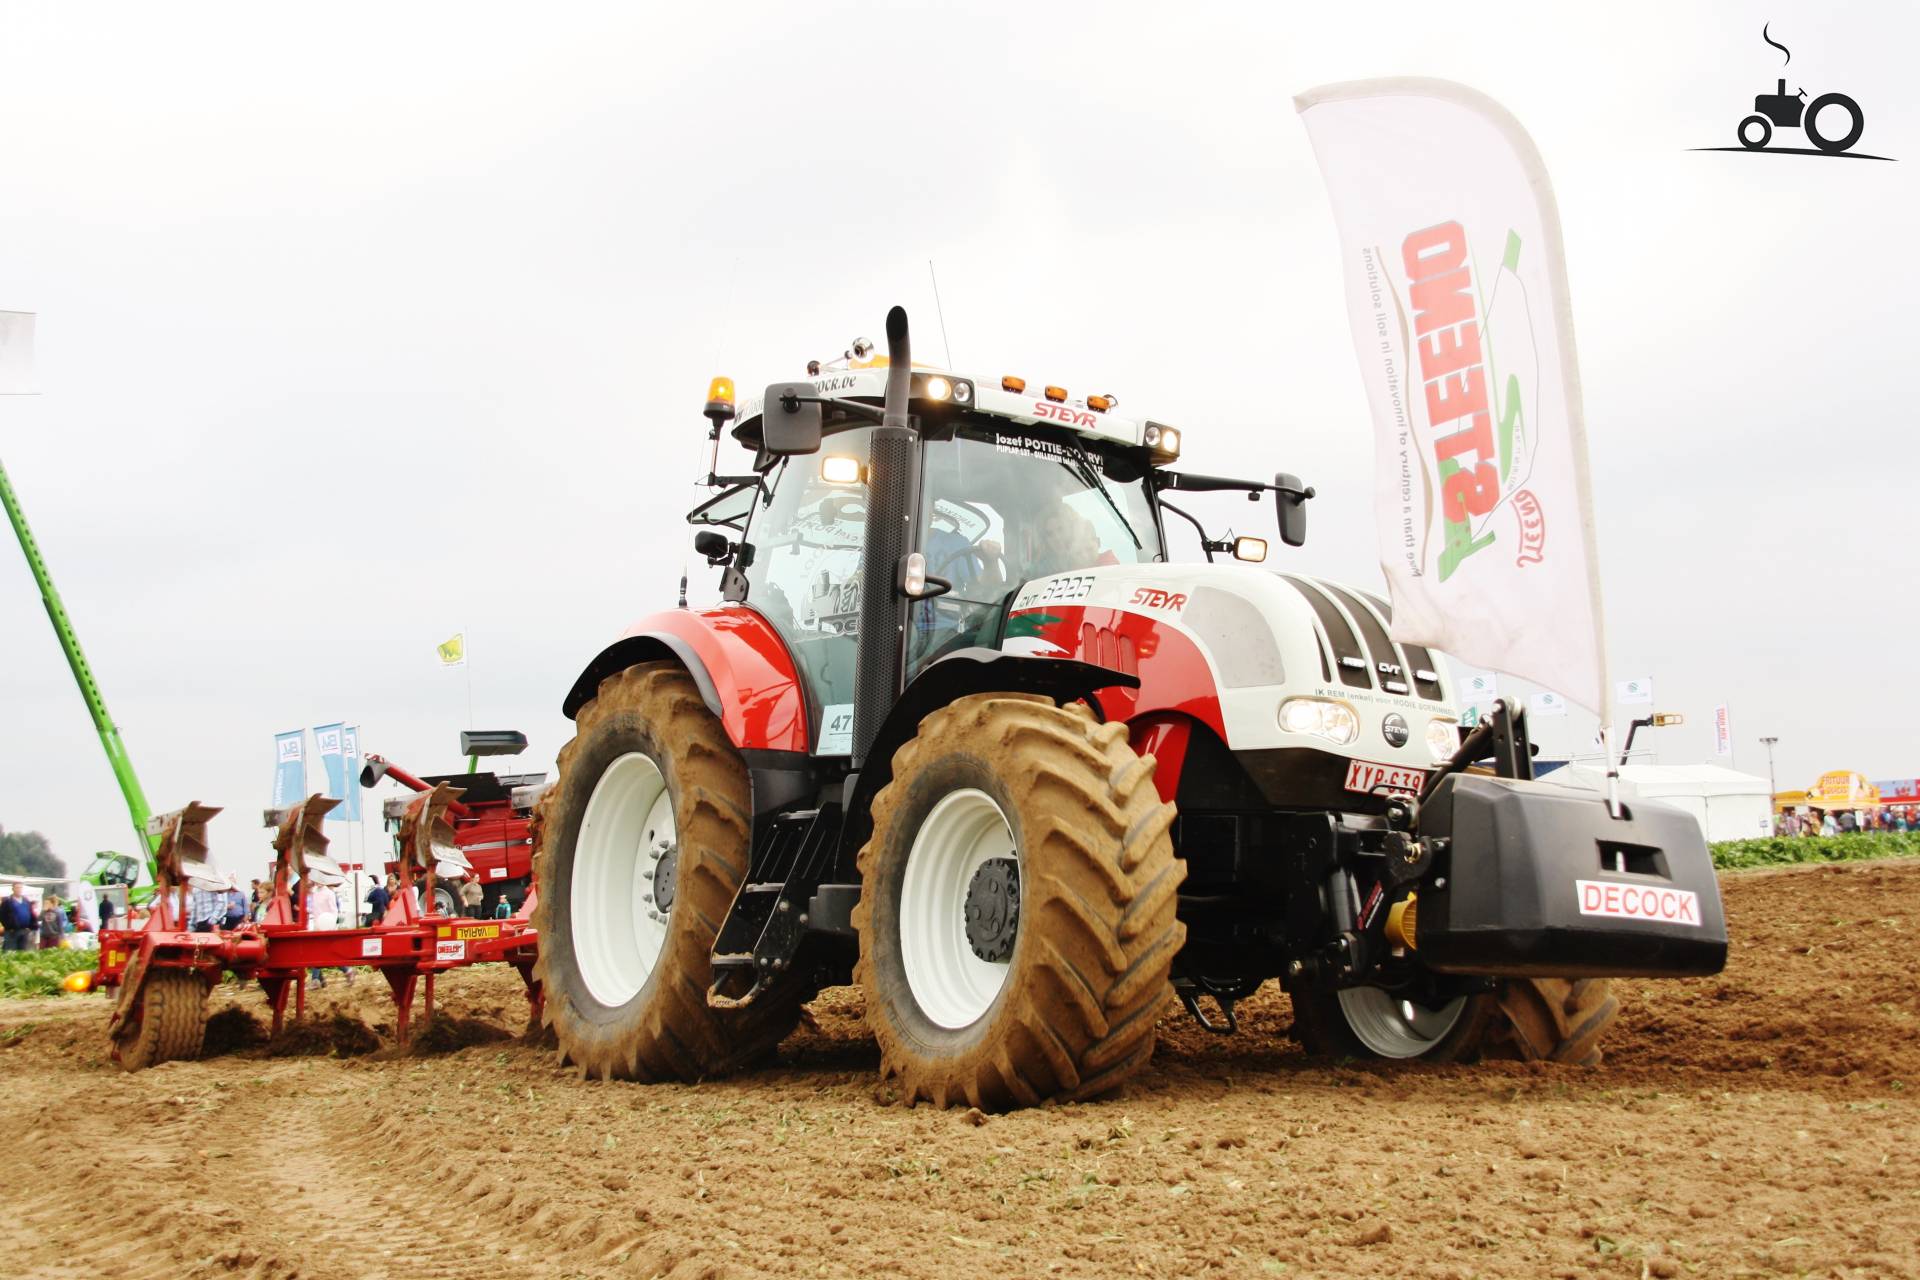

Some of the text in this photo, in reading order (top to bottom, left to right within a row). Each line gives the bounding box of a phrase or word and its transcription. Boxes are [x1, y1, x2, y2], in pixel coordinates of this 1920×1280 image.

[1032, 401, 1097, 429] STEYR
[995, 432, 1023, 447] Jozef
[1128, 587, 1189, 612] STEYR
[1378, 661, 1401, 675] CVT
[1315, 688, 1325, 697] IK
[1327, 689, 1345, 698] REM
[830, 714, 853, 732] 47
[1384, 725, 1408, 735] STEYR
[1583, 884, 1693, 921] DECOCK
[457, 926, 488, 939] VARIAL
